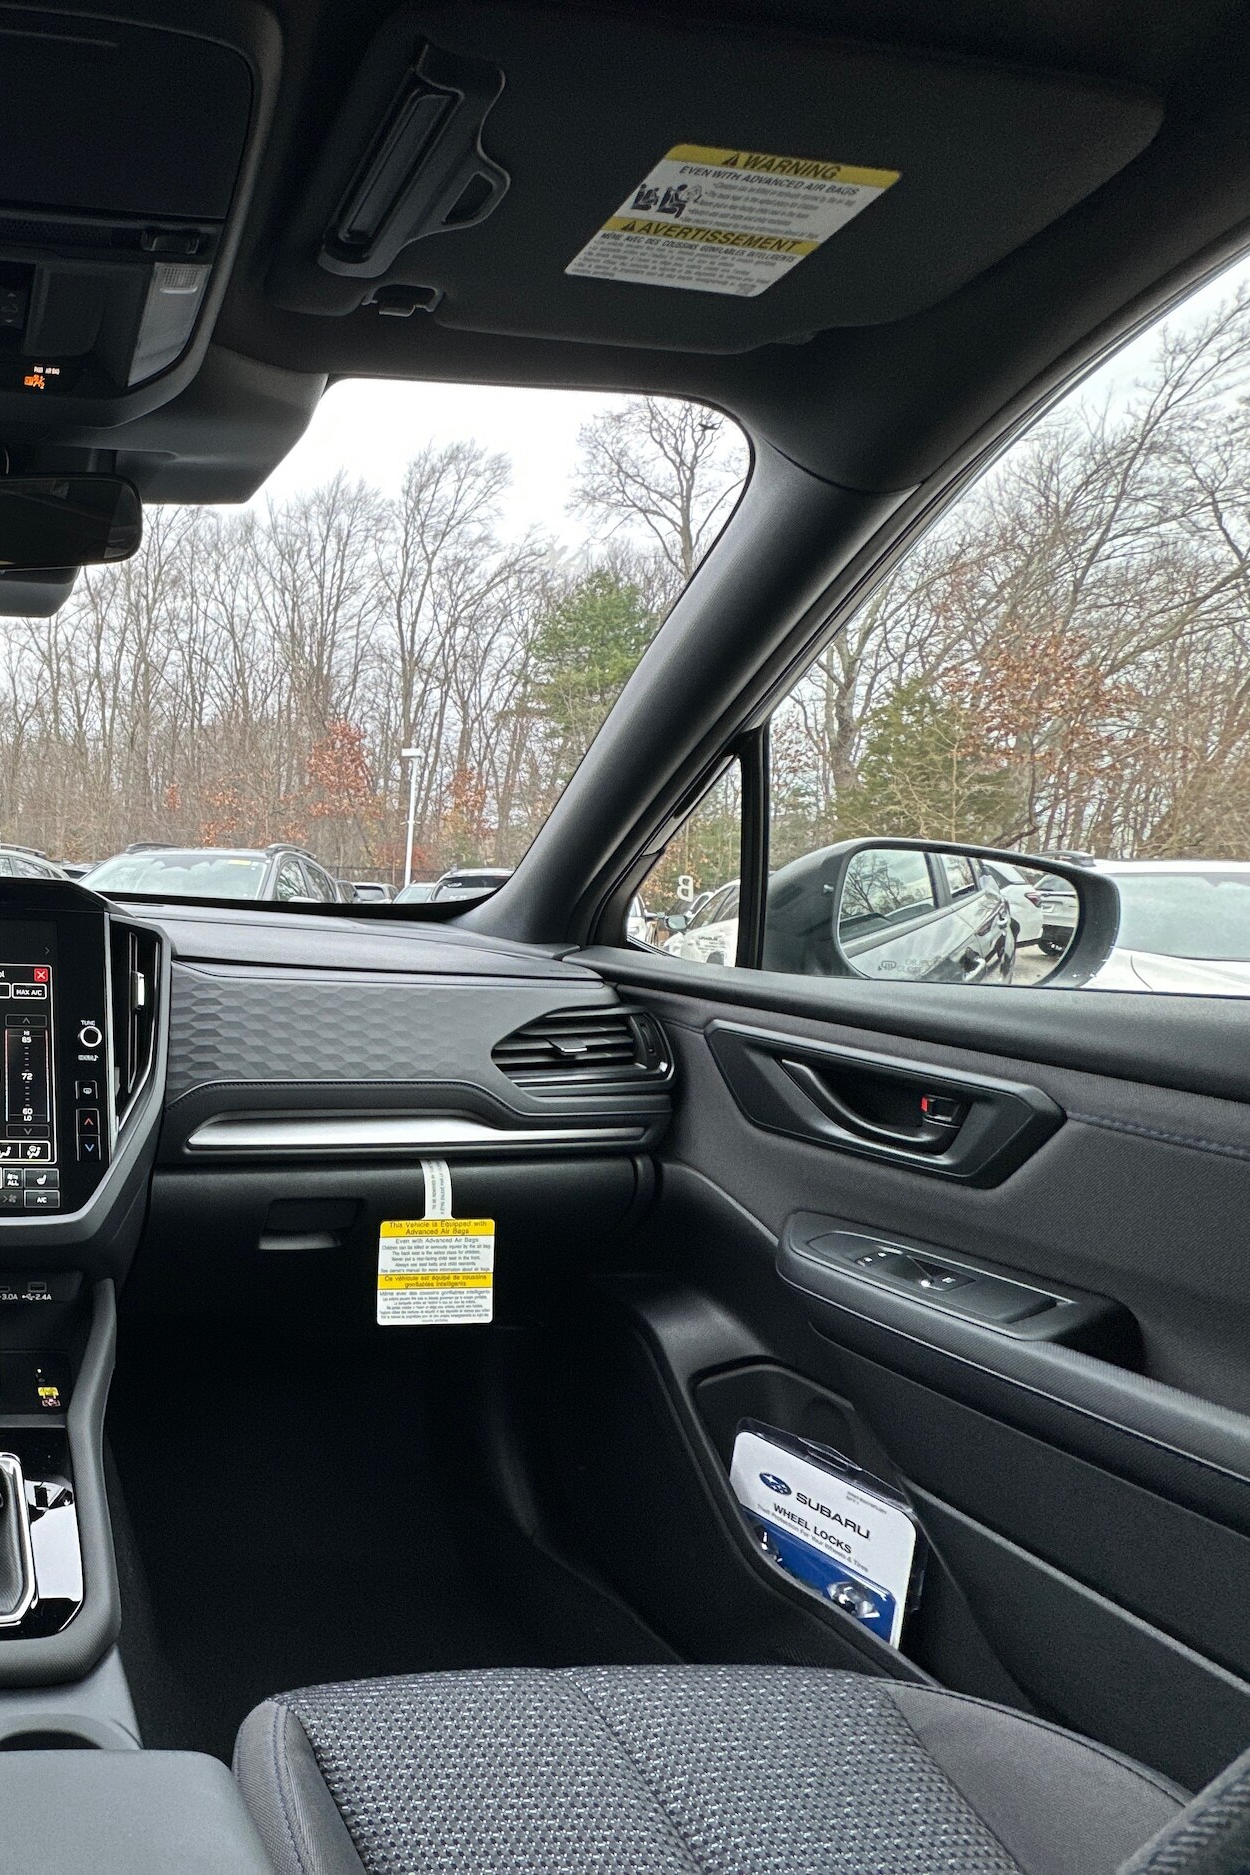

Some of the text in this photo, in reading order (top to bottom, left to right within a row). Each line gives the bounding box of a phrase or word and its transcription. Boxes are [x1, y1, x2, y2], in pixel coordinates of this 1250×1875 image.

[678, 165, 860, 196] EVEN WITH ADVANCED AIR BAGS
[743, 153, 841, 180] WARNING
[638, 221, 802, 252] AVERTISSEMENT
[16, 988, 30, 996] MAX
[440, 1220, 471, 1230] Equipped
[453, 1228, 469, 1236] Bags
[432, 1274, 450, 1282] équipé
[774, 1502, 852, 1554] WHEEL LOCKS
[796, 1492, 870, 1539] SUBARU
[757, 1504, 771, 1516] Theft
[771, 1511, 799, 1532] Protection
[800, 1528, 809, 1538] For
[811, 1534, 824, 1546] Your
[824, 1541, 846, 1560] Wheels
[854, 1559, 869, 1573] Tires
